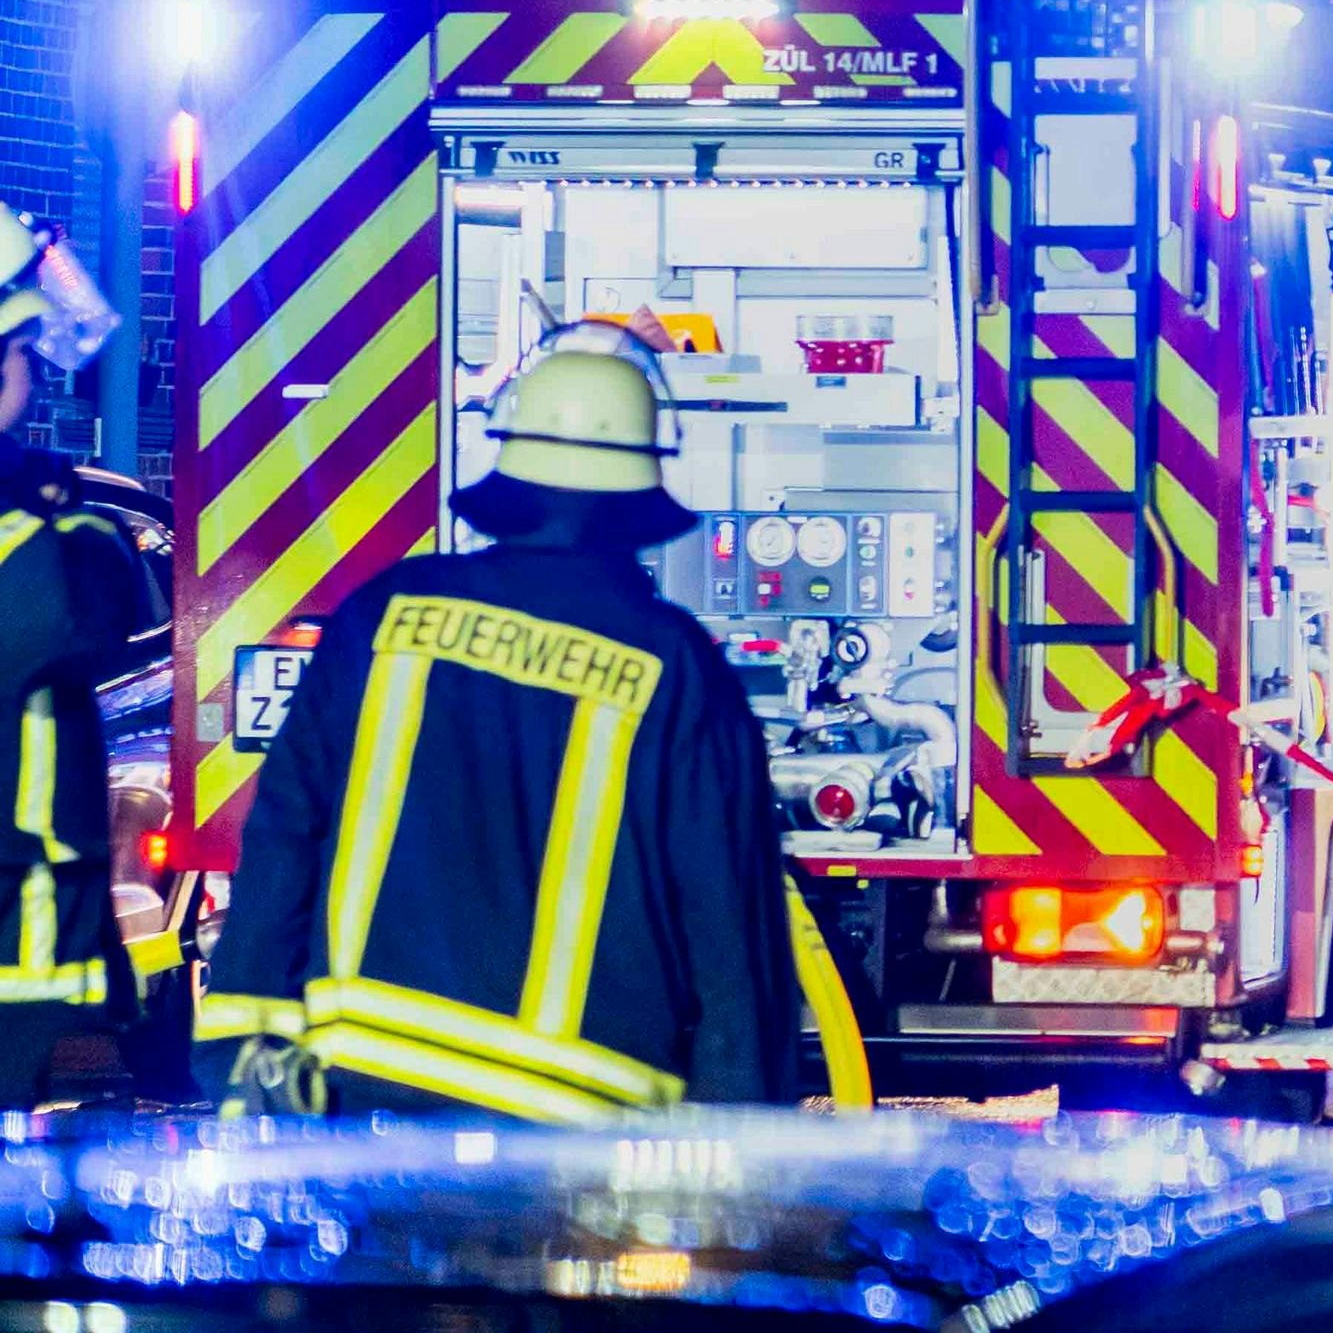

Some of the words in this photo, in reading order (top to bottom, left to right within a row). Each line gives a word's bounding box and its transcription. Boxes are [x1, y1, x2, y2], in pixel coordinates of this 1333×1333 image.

[762, 44, 816, 72] ZÜL
[824, 51, 918, 73] 14/MLF
[925, 52, 938, 74] 1
[874, 152, 905, 169] GR
[388, 604, 646, 704] FEUERWEHR
[274, 656, 305, 690] E
